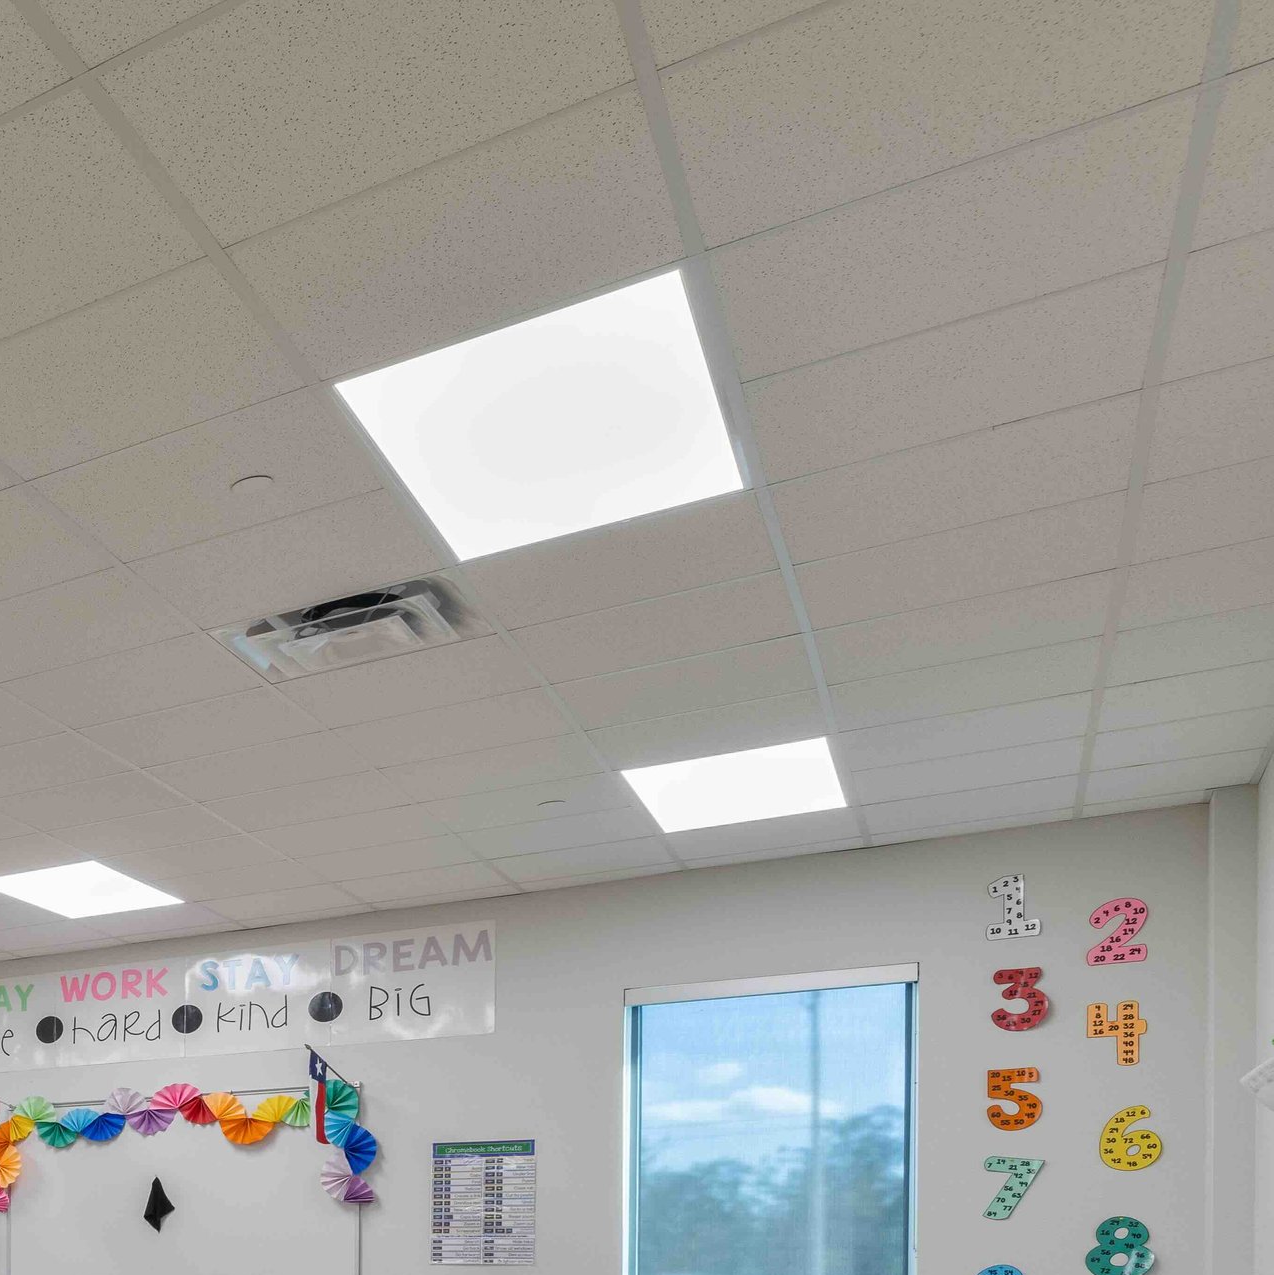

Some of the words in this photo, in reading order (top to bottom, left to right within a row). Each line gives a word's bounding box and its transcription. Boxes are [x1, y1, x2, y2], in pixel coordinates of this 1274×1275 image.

[986, 874, 1041, 941] 1
[1086, 898, 1148, 966] 2
[60, 967, 169, 1003] WORK
[201, 954, 300, 991] STAY
[334, 929, 493, 977] DREAM
[991, 967, 1049, 1031] 3
[1087, 1000, 1147, 1066] 4
[987, 1067, 1043, 1131] 5
[487, 1144, 522, 1152] Shortcuts
[1099, 1105, 1162, 1171] 6
[982, 1156, 1045, 1220] 7
